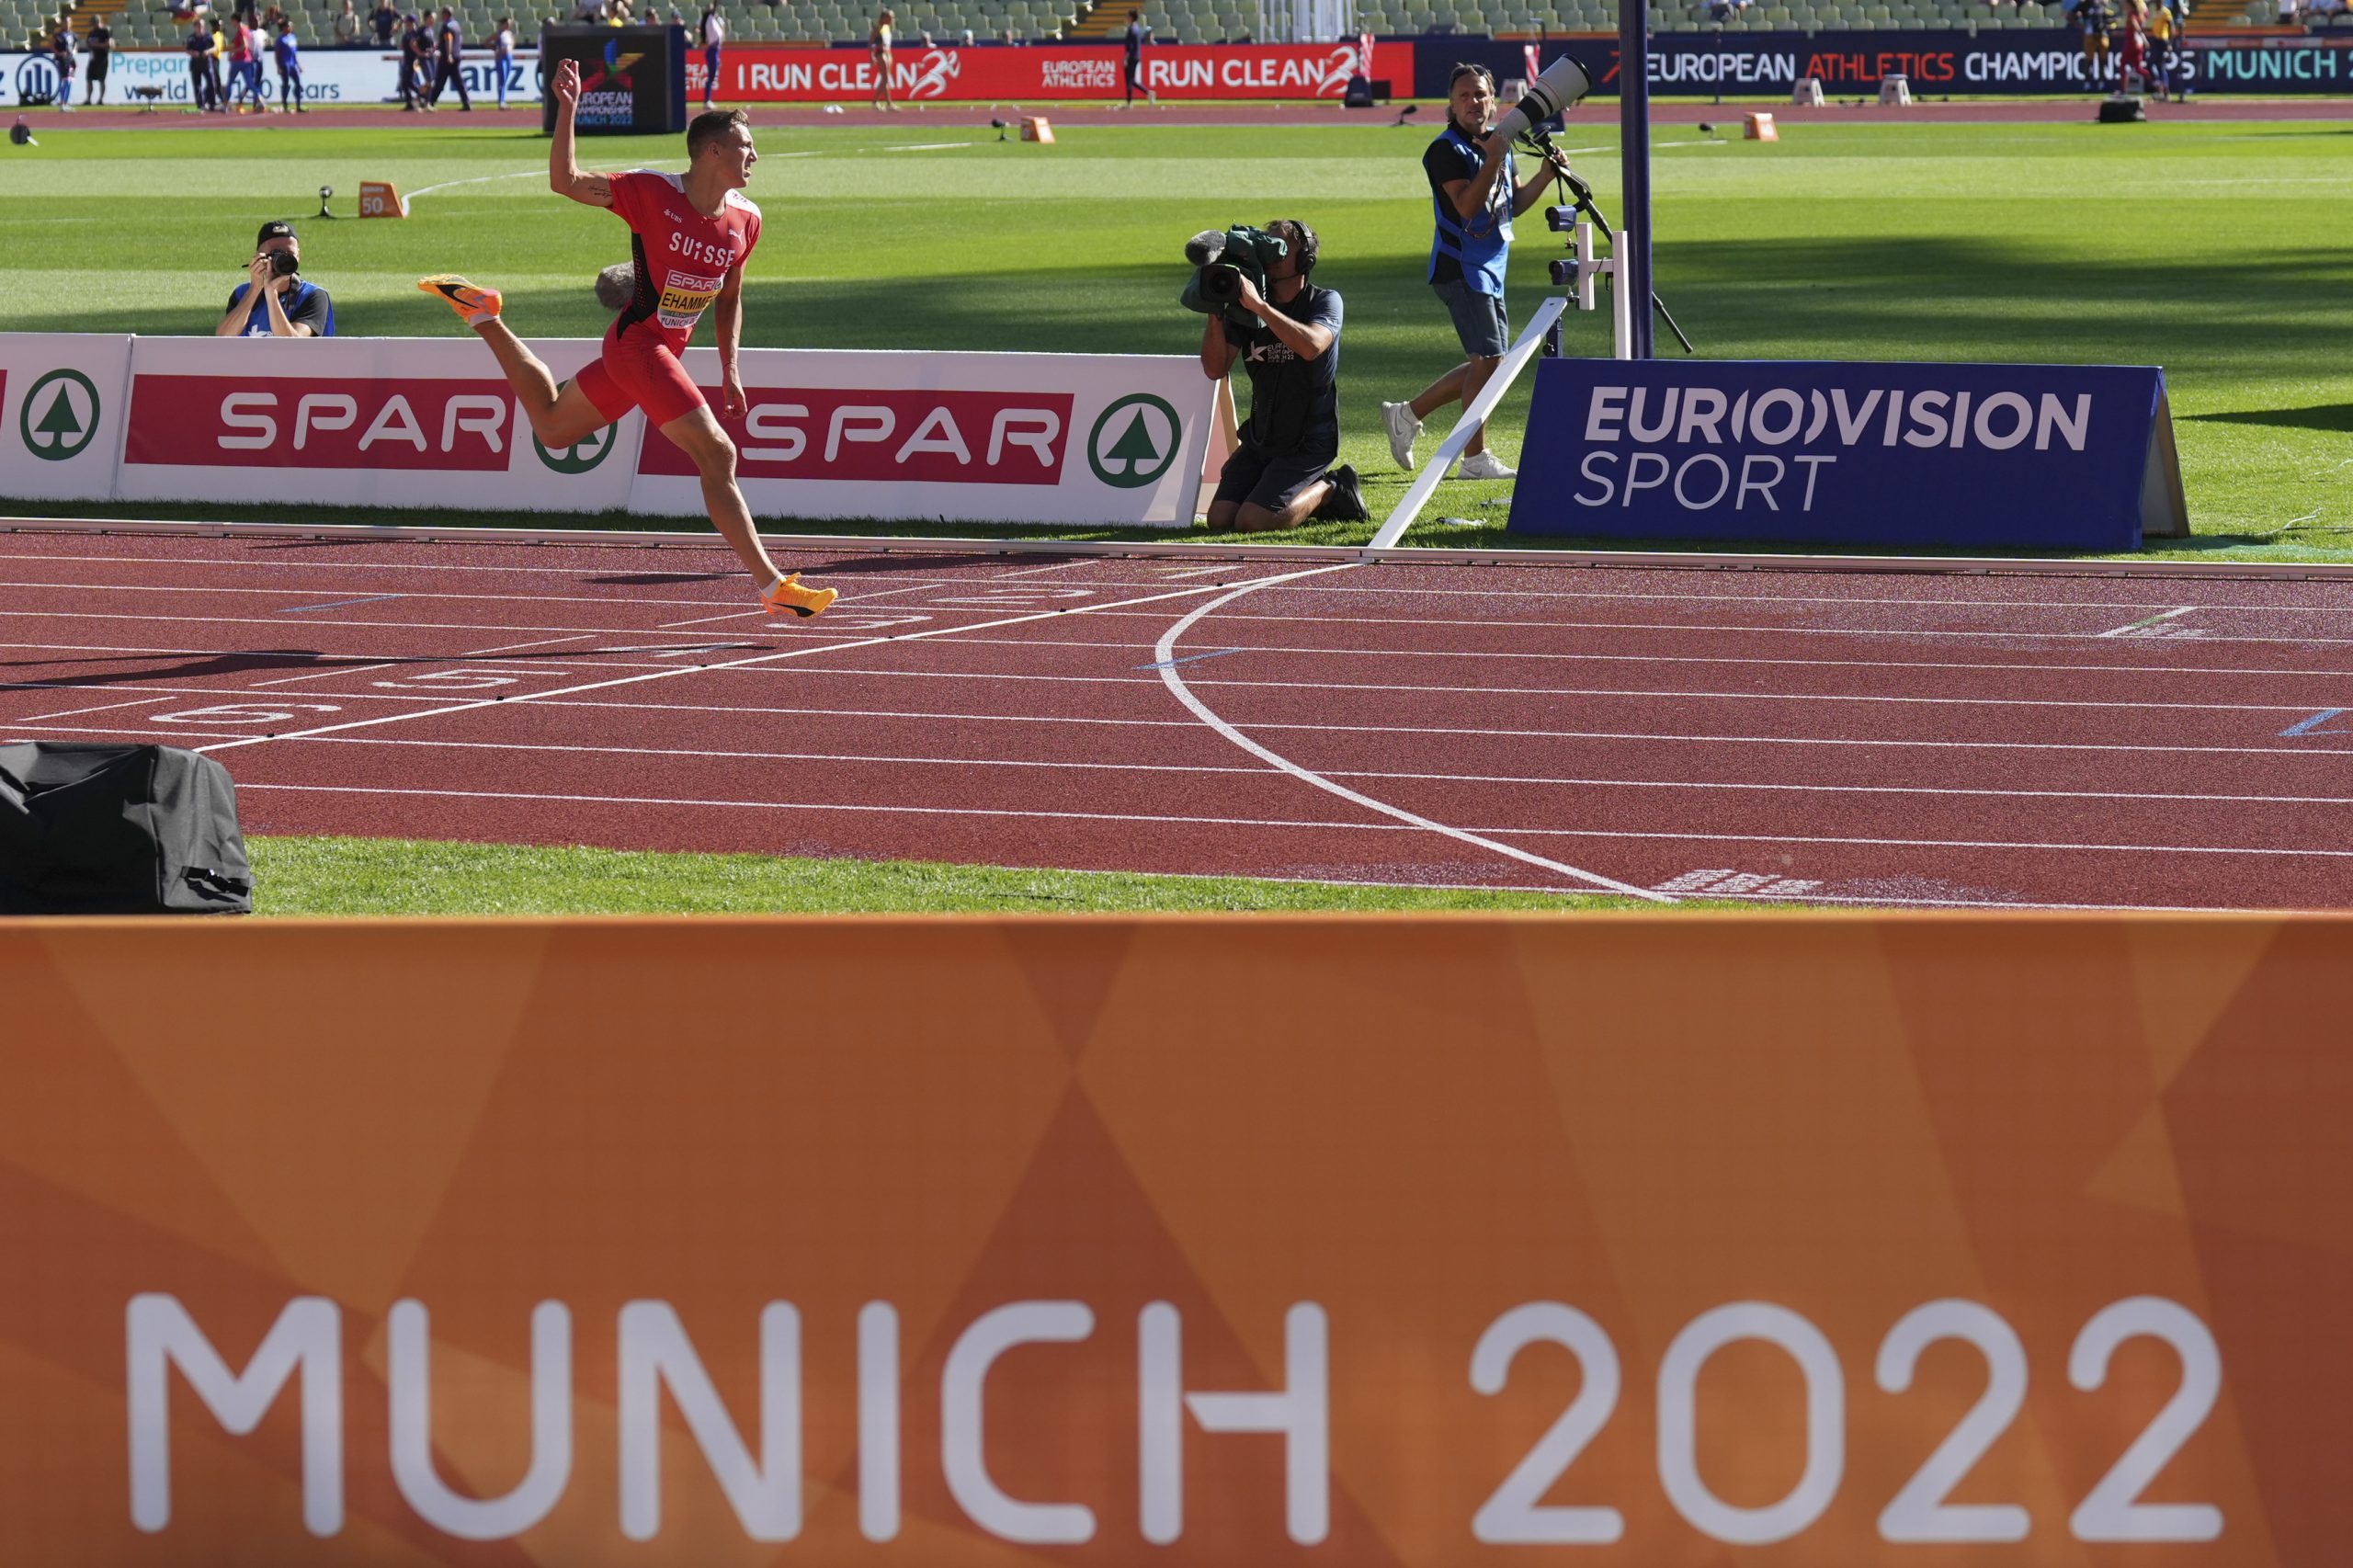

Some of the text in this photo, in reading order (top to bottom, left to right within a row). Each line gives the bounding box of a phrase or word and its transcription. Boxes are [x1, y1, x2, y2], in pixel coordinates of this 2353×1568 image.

[737, 63, 745, 90] I
[751, 63, 811, 90] RUN
[1042, 61, 1115, 73] EUROPEAN
[1150, 60, 1213, 86] RUN
[1222, 59, 1324, 86] CLEAN
[1647, 53, 1795, 82] EUROPEAN
[1805, 52, 1955, 82] ATHLETICS
[2208, 50, 2336, 79] MUNICH
[1041, 74, 1115, 87] ATHLETICS
[578, 91, 633, 105] UROPEAN
[362, 198, 383, 214] 50
[669, 274, 714, 290] SPAR
[217, 392, 506, 453] SPAR
[741, 403, 1061, 468] SPAR
[1573, 450, 1837, 512] SPORT
[371, 668, 571, 689] 5
[149, 703, 342, 724] 6
[126, 1292, 2224, 1547] MUNICH 2022
